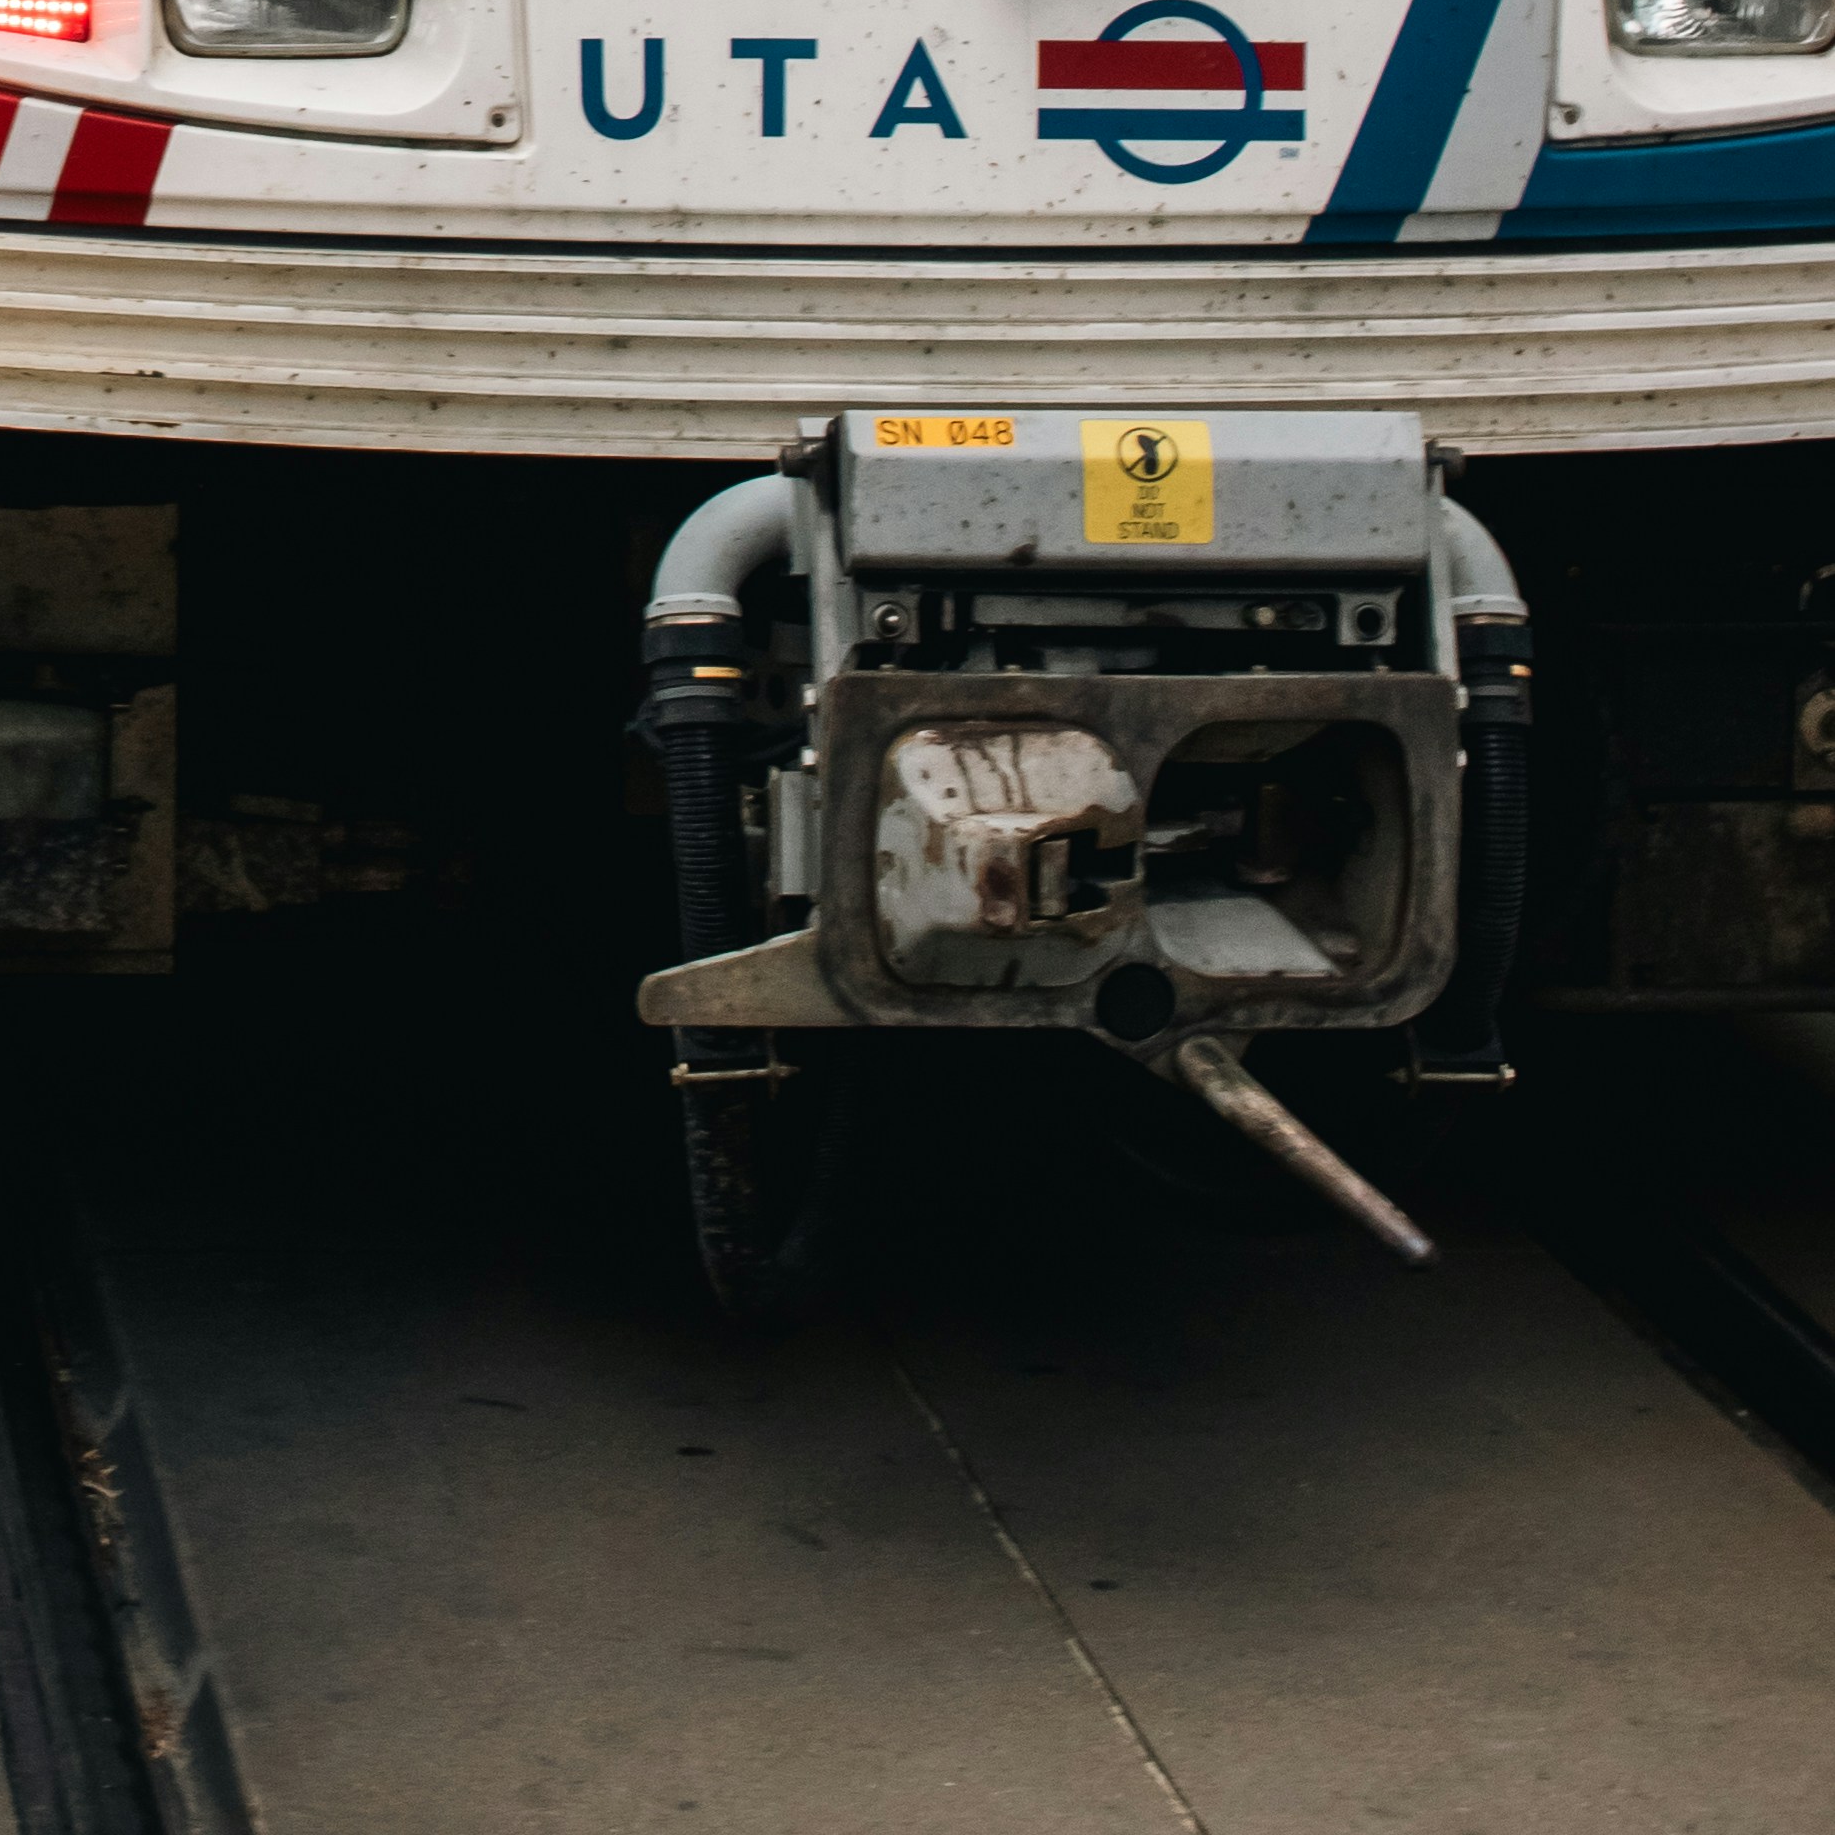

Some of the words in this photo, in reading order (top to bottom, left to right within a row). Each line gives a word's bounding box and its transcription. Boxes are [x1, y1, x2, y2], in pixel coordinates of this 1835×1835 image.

[580, 36, 969, 141] UTA
[877, 420, 923, 446] SN
[1117, 521, 1180, 540] STAND
